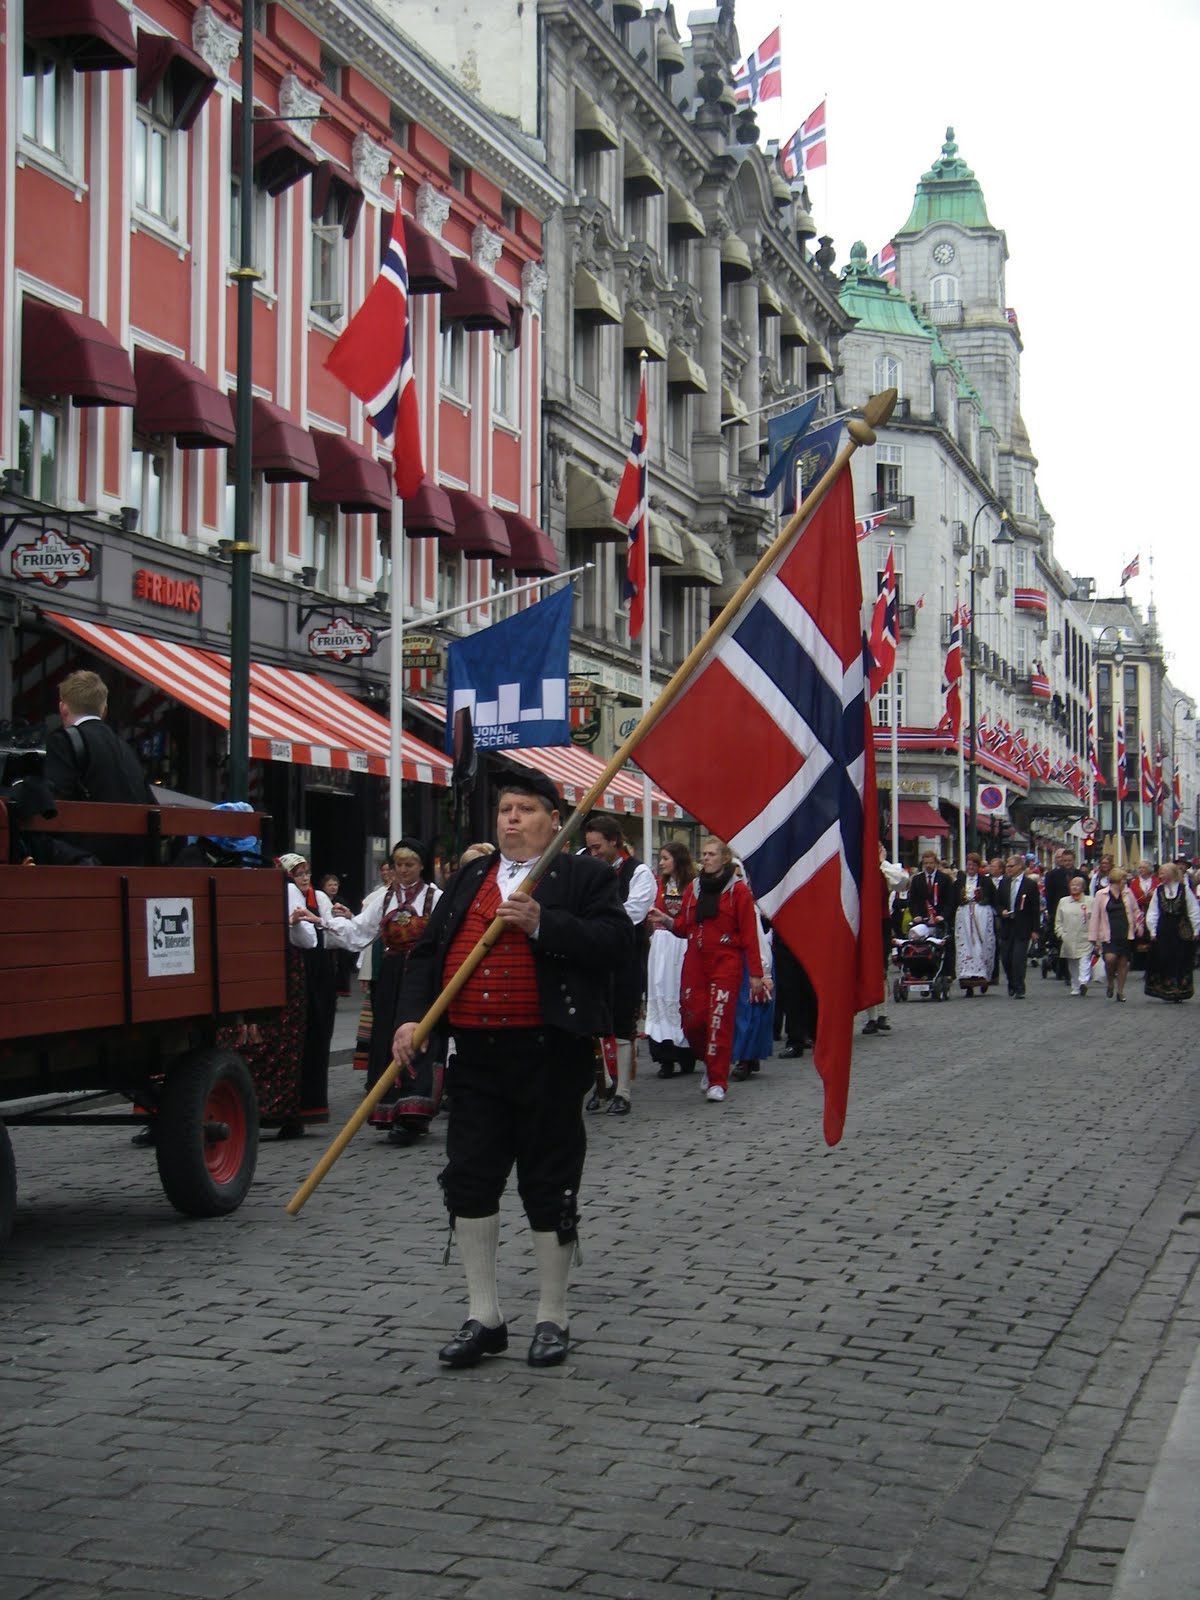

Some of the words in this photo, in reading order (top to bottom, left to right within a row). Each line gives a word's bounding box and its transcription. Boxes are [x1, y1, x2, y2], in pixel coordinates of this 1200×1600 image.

[22, 552, 81, 566] FRIDAY'S
[317, 635, 364, 646] FRIDAY'S
[473, 725, 512, 737] JONAL
[473, 733, 520, 748] ZSCENE
[706, 988, 730, 1056] MARIE
